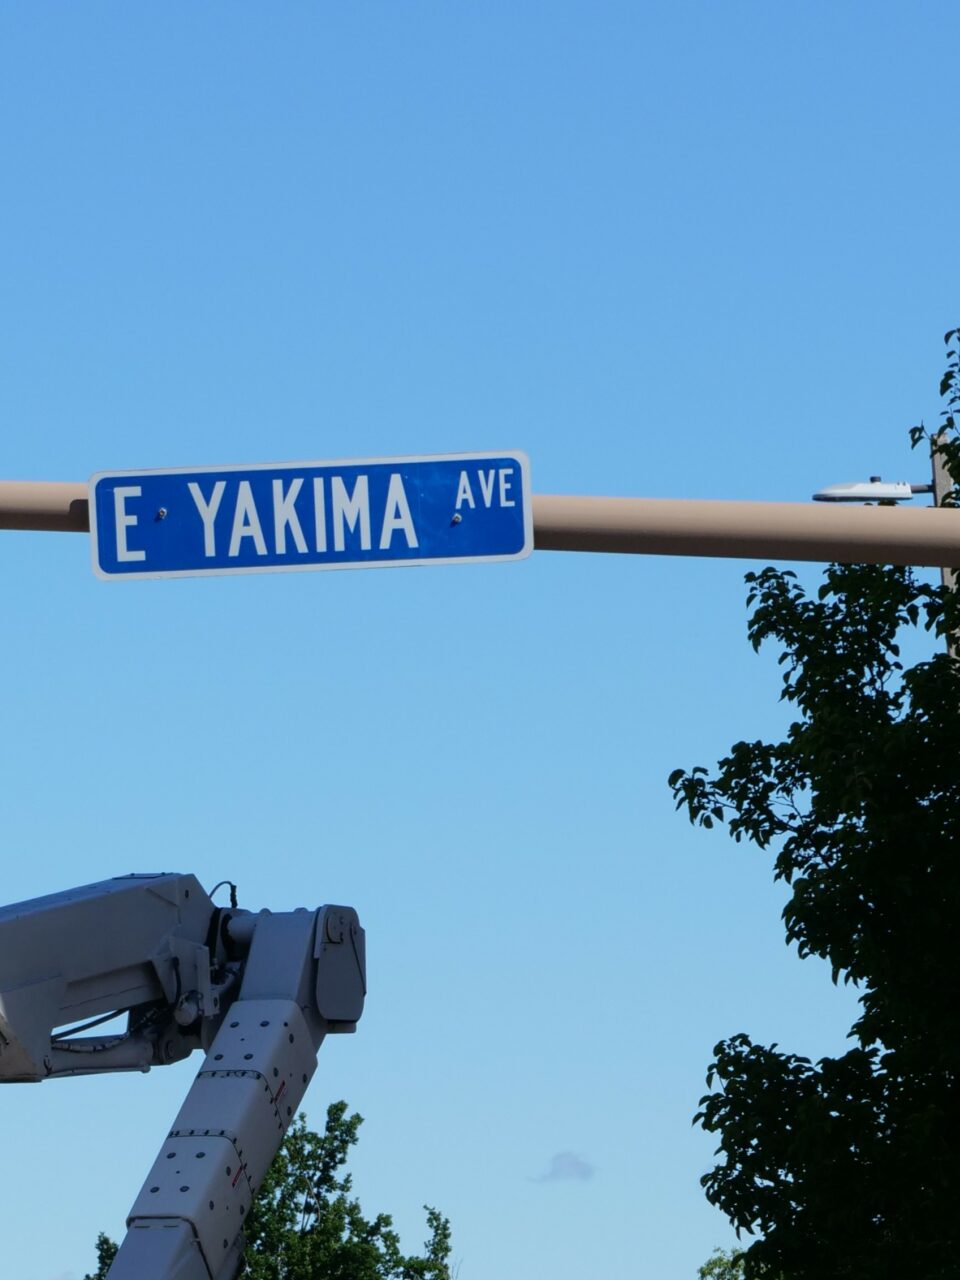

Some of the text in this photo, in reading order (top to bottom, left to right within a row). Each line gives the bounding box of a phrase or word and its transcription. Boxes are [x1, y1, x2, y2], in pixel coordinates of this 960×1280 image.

[114, 468, 516, 562] E YAKIMA AVE
